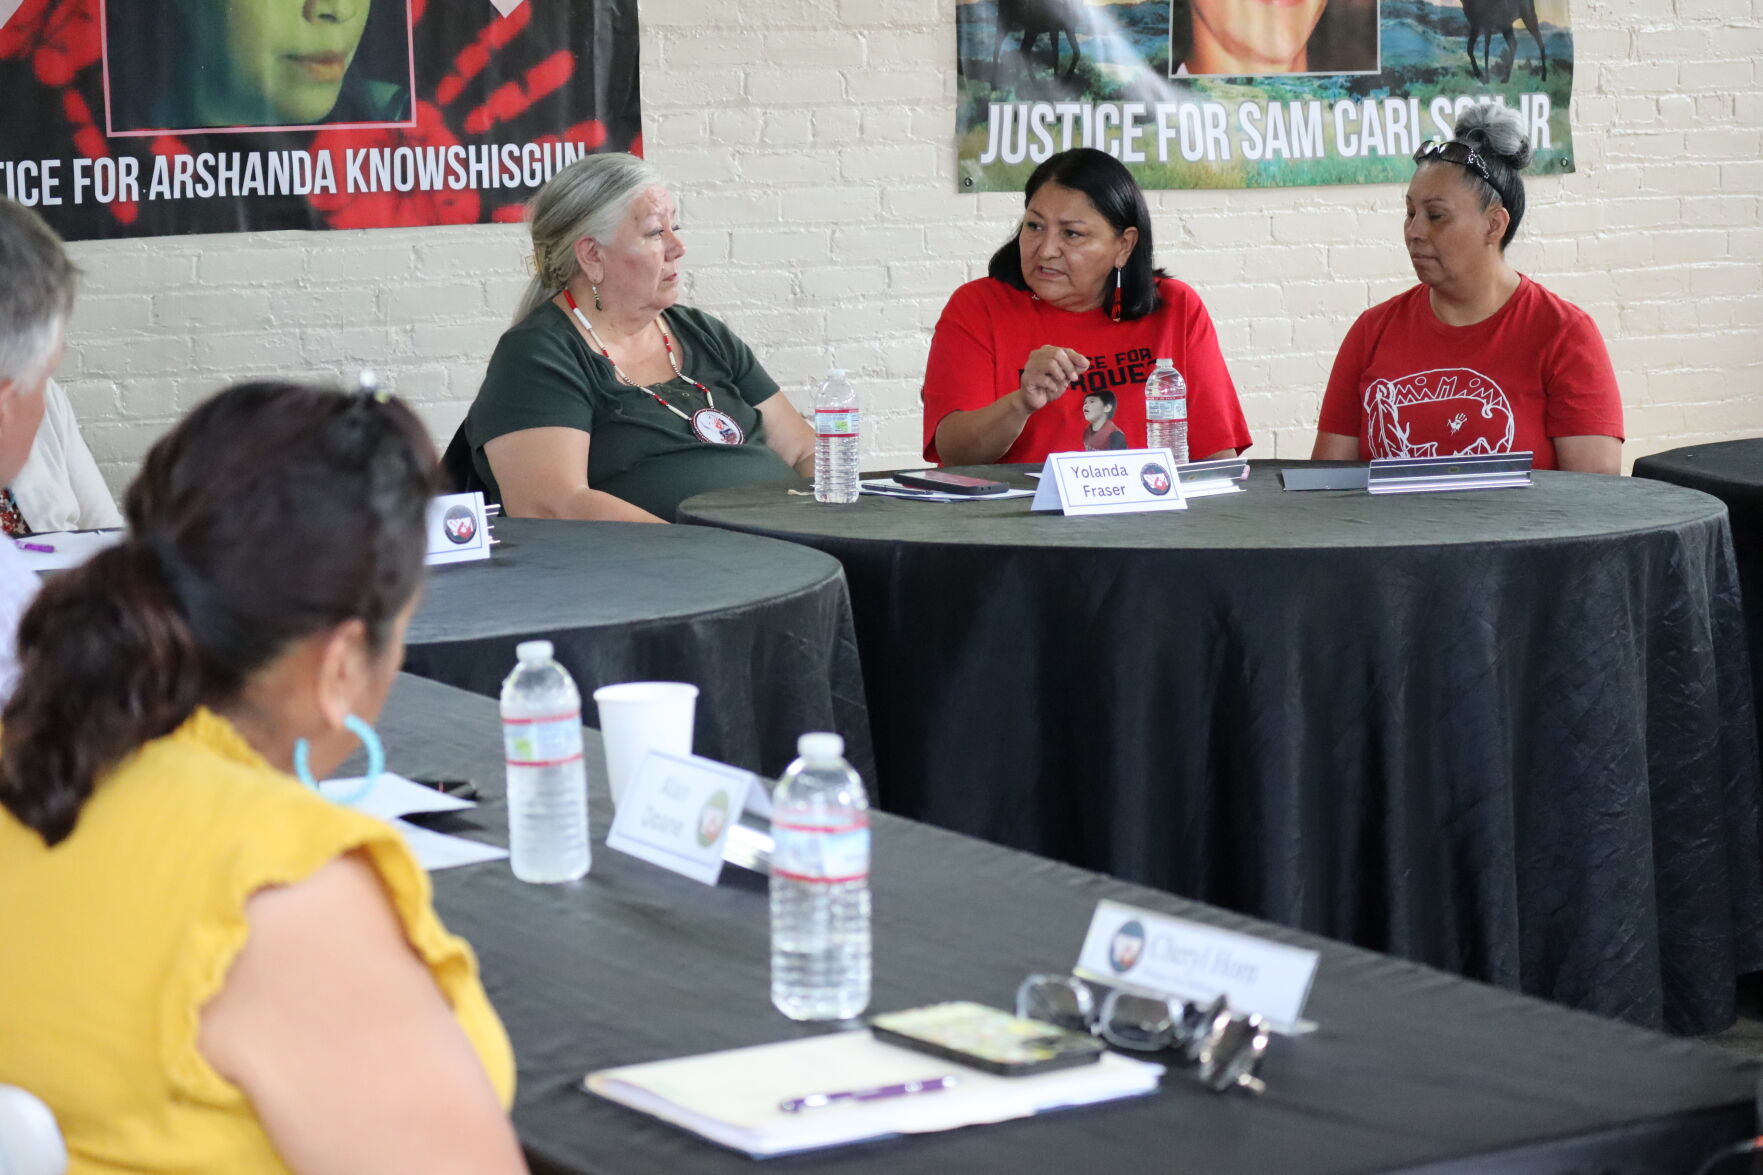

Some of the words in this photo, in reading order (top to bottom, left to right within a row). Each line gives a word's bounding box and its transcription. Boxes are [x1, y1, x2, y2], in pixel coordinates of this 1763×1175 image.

[981, 101, 1146, 164] JUSTICE
[1157, 101, 1231, 162] FOR
[1238, 100, 1325, 160] SAM
[0, 159, 62, 207] ICE
[73, 156, 139, 205] FOR
[149, 149, 337, 200] ARSHANDA
[1115, 348, 1151, 365] FOR
[1071, 464, 1129, 479] Yolanda
[1083, 484, 1126, 498] Fraser
